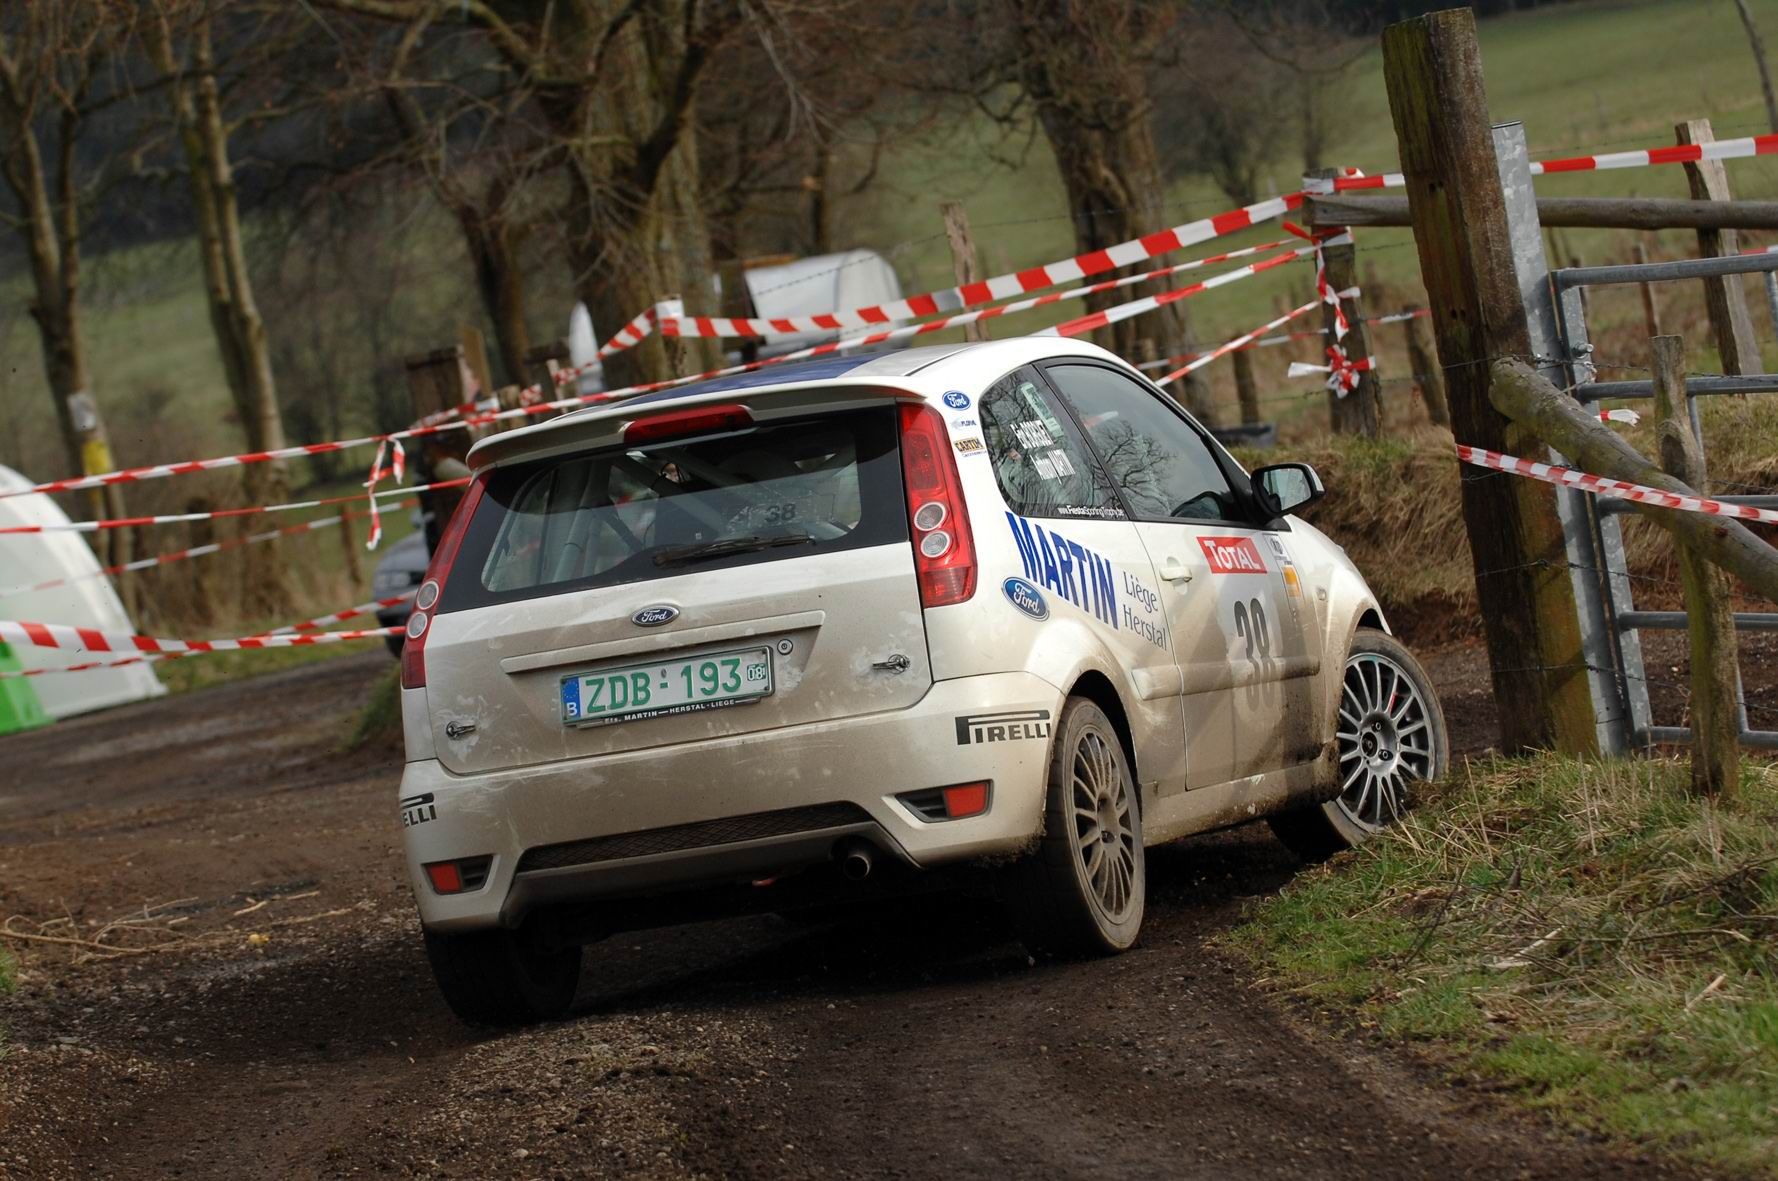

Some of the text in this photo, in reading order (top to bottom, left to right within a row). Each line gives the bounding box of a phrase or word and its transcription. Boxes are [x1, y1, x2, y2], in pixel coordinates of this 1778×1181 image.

[765, 503, 796, 523] 38
[1005, 511, 1119, 630] MARTIN
[1123, 571, 1159, 614] Liège
[1122, 604, 1167, 651] Herstal
[1234, 598, 1277, 713] 38
[566, 702, 578, 716] B
[955, 709, 1051, 745] PIRELLI
